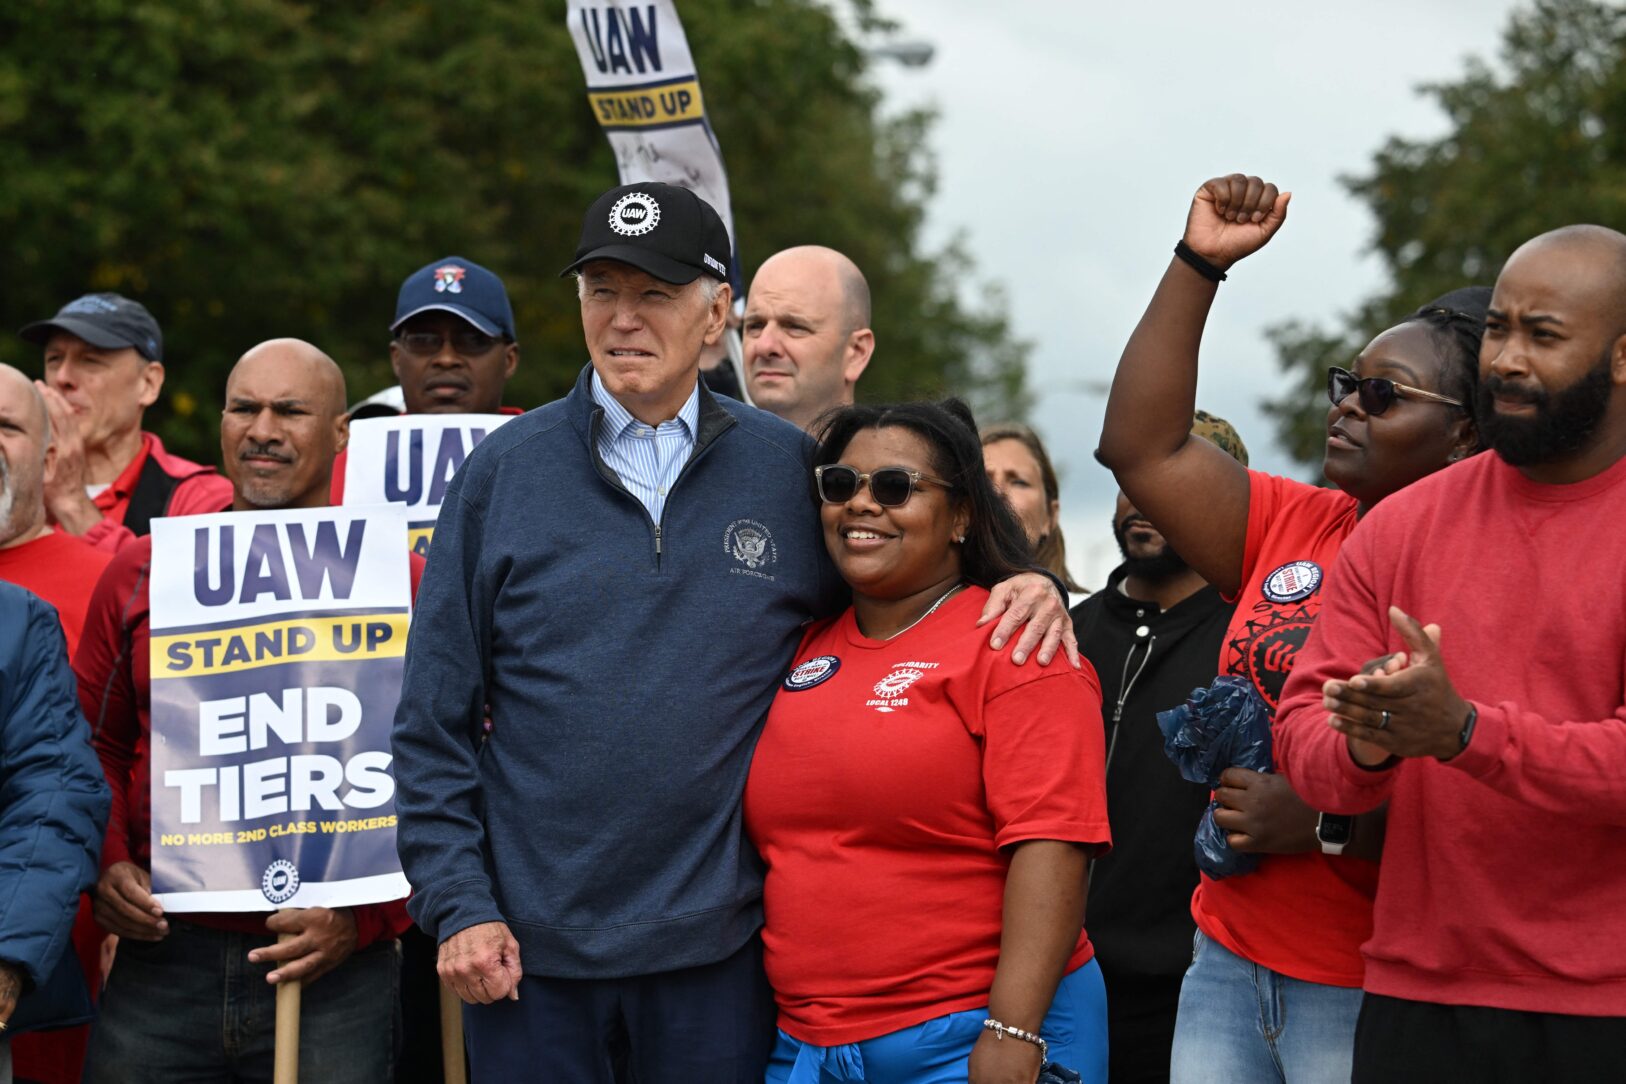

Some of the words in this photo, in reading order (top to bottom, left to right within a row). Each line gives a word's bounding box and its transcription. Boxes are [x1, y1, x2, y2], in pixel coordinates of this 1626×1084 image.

[580, 5, 663, 75] UAW
[597, 96, 656, 121] STAND
[659, 90, 692, 116] UP
[621, 208, 647, 219] UAW
[384, 427, 487, 507] UA
[193, 519, 367, 607] UAW
[1282, 568, 1298, 593] STRIKE
[1310, 566, 1320, 589] REGION
[166, 626, 316, 671] STAND
[332, 622, 393, 653] UP
[793, 666, 826, 678] STRIKE
[200, 687, 363, 757] END
[164, 751, 396, 823] TIERS
[161, 834, 185, 846] NO
[188, 832, 234, 846] MORE
[237, 828, 267, 843] 2ND
[269, 821, 317, 838] CLASS
[320, 815, 398, 834] WORKERS
